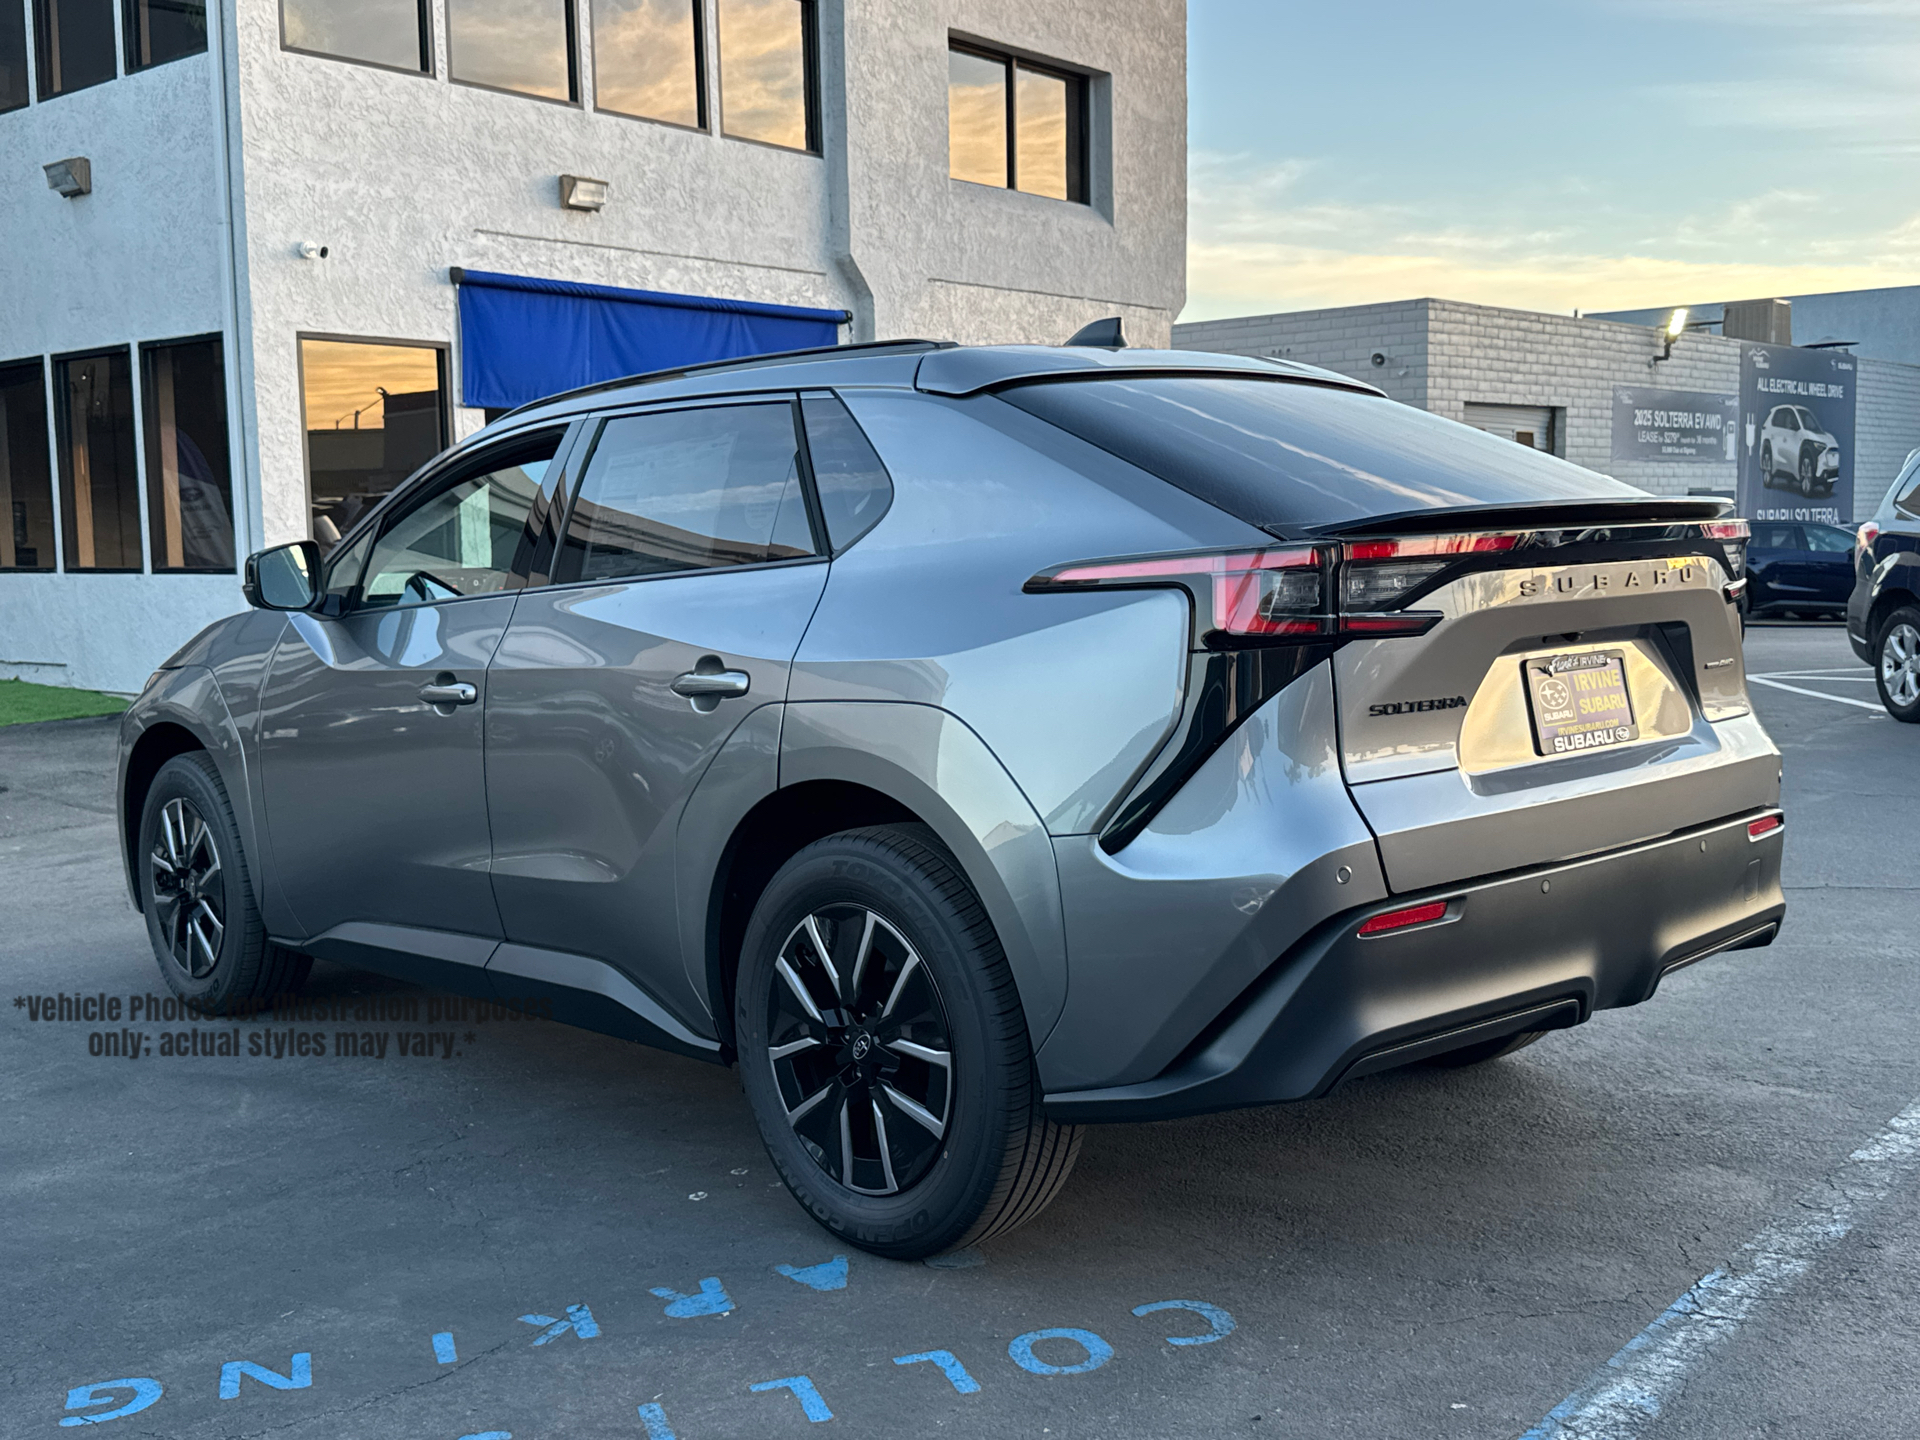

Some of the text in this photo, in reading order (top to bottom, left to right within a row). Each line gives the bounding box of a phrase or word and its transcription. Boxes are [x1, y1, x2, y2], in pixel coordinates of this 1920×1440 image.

[1757, 377, 1769, 392] ALL
[1769, 378, 1796, 394] ELECTRIC
[1797, 381, 1809, 395] ALL
[1653, 410, 1694, 429] SOLTERRA
[1694, 412, 1705, 429] EV
[1705, 413, 1722, 430] AWD
[1638, 430, 1659, 443] LEASE
[1519, 567, 1694, 597] SUBARU
[1579, 655, 1606, 666] IRVINE
[1573, 669, 1621, 691] IRVINE
[1368, 696, 1468, 717] SOLTERRA
[1579, 693, 1626, 715] SUBARU
[1544, 709, 1574, 721] SUBARU
[1557, 718, 1619, 736] IRVINESUBARU.COM
[1554, 728, 1615, 752] SUBARU
